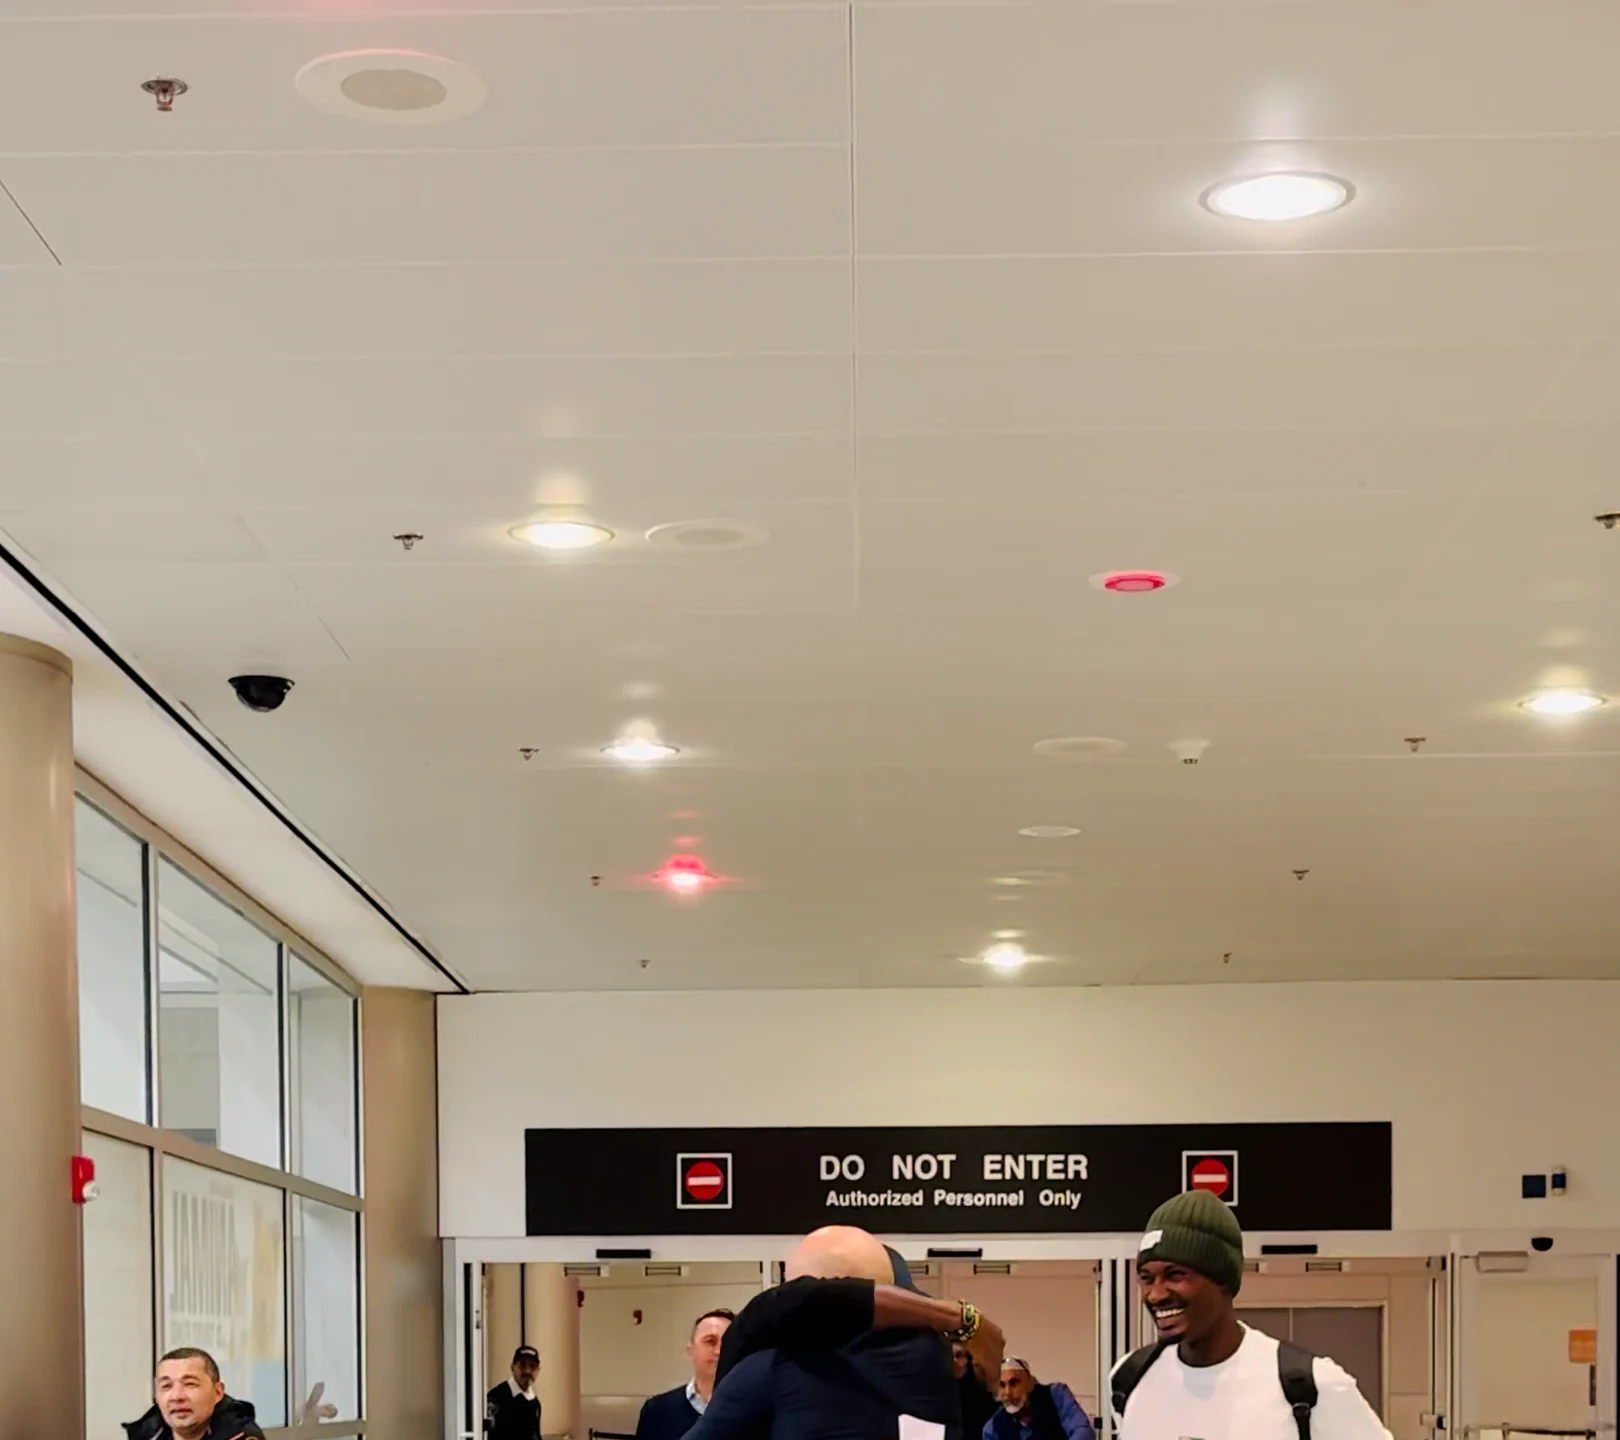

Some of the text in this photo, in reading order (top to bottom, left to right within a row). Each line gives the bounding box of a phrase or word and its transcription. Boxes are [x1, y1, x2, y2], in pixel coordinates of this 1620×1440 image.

[820, 1154, 1089, 1181] DO NOT ENTER
[825, 1189, 1082, 1210] Authorized Personnel Only
